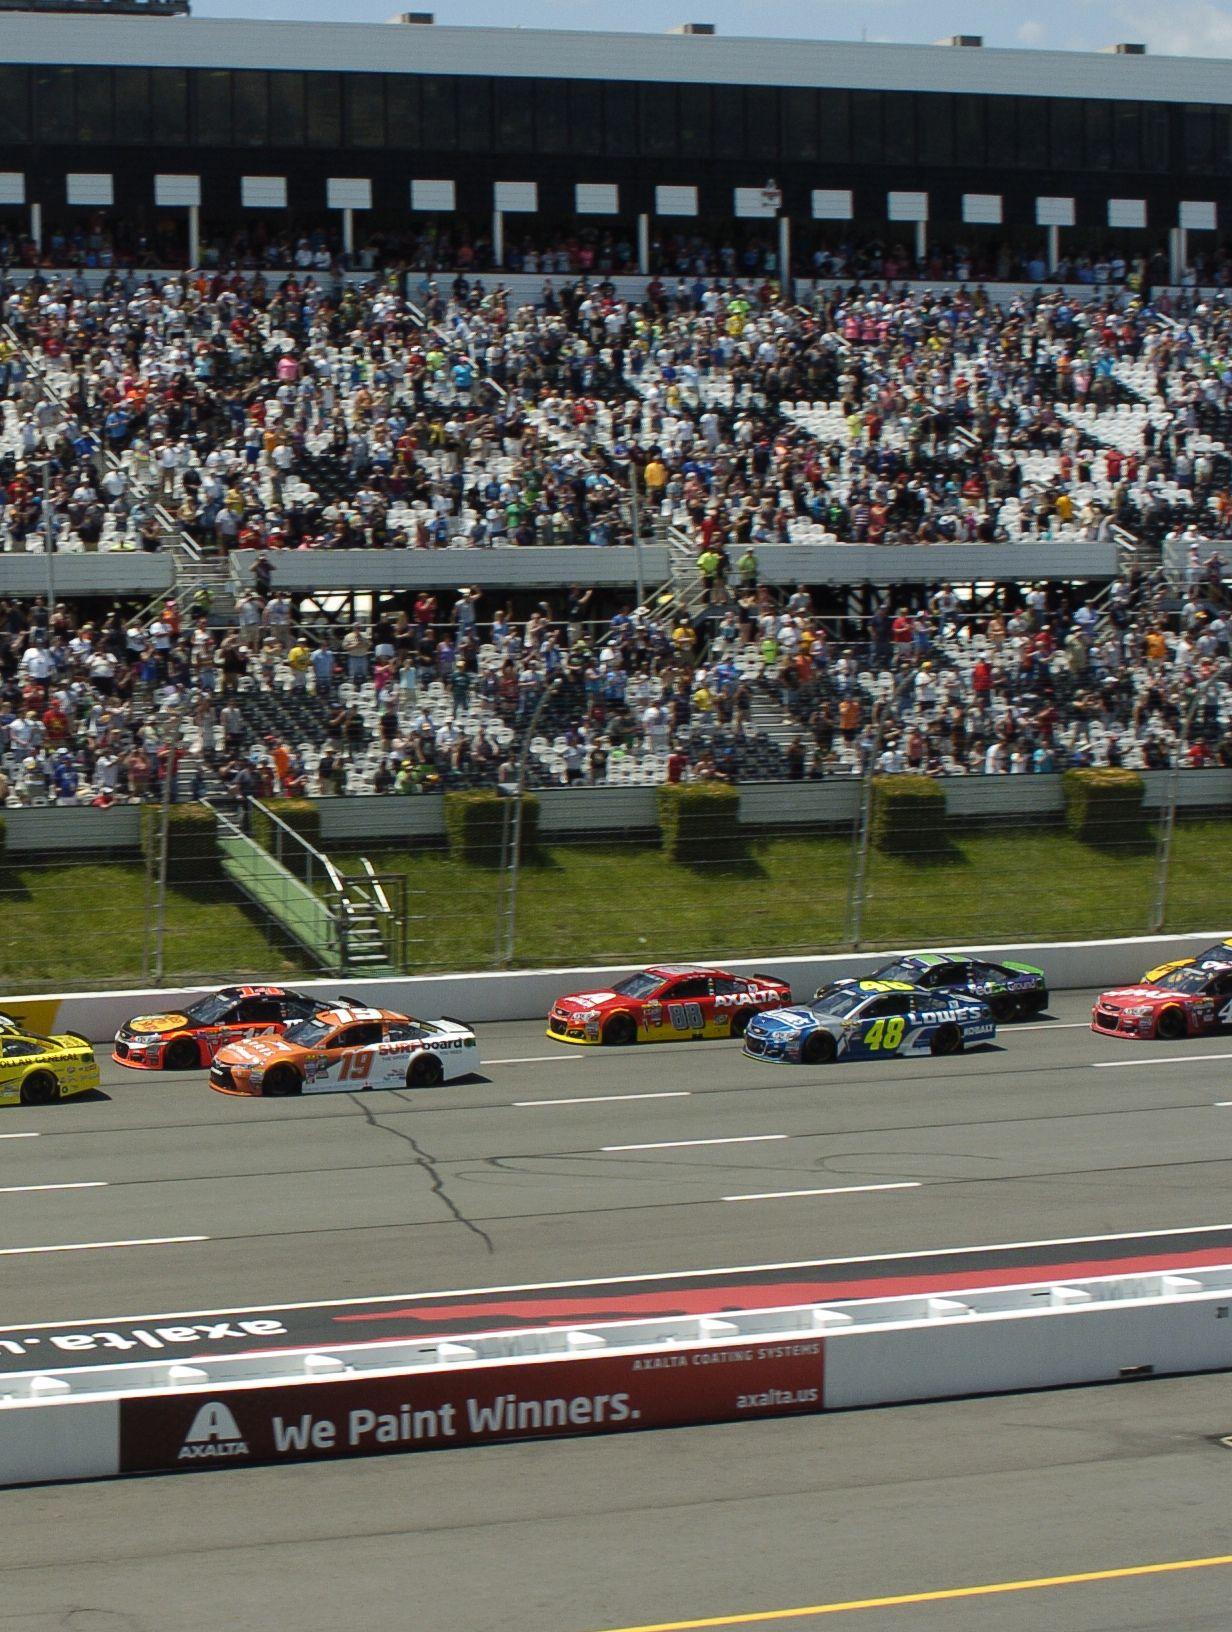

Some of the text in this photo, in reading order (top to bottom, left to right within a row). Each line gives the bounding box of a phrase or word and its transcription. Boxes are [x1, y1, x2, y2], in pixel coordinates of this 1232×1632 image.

[714, 989, 781, 1007] AXALTA
[668, 1002, 705, 1030] 88
[909, 1006, 982, 1025] LOWE'S
[864, 1017, 905, 1050] 48
[35, 1052, 79, 1063] GENERAL
[337, 1049, 375, 1082] 19
[631, 1343, 821, 1372] AXALTA COATING SYSTEMS
[736, 1387, 819, 1410] axalta.us
[271, 1392, 642, 1452] We Paint Winners.
[177, 1440, 250, 1460] AXALTA
